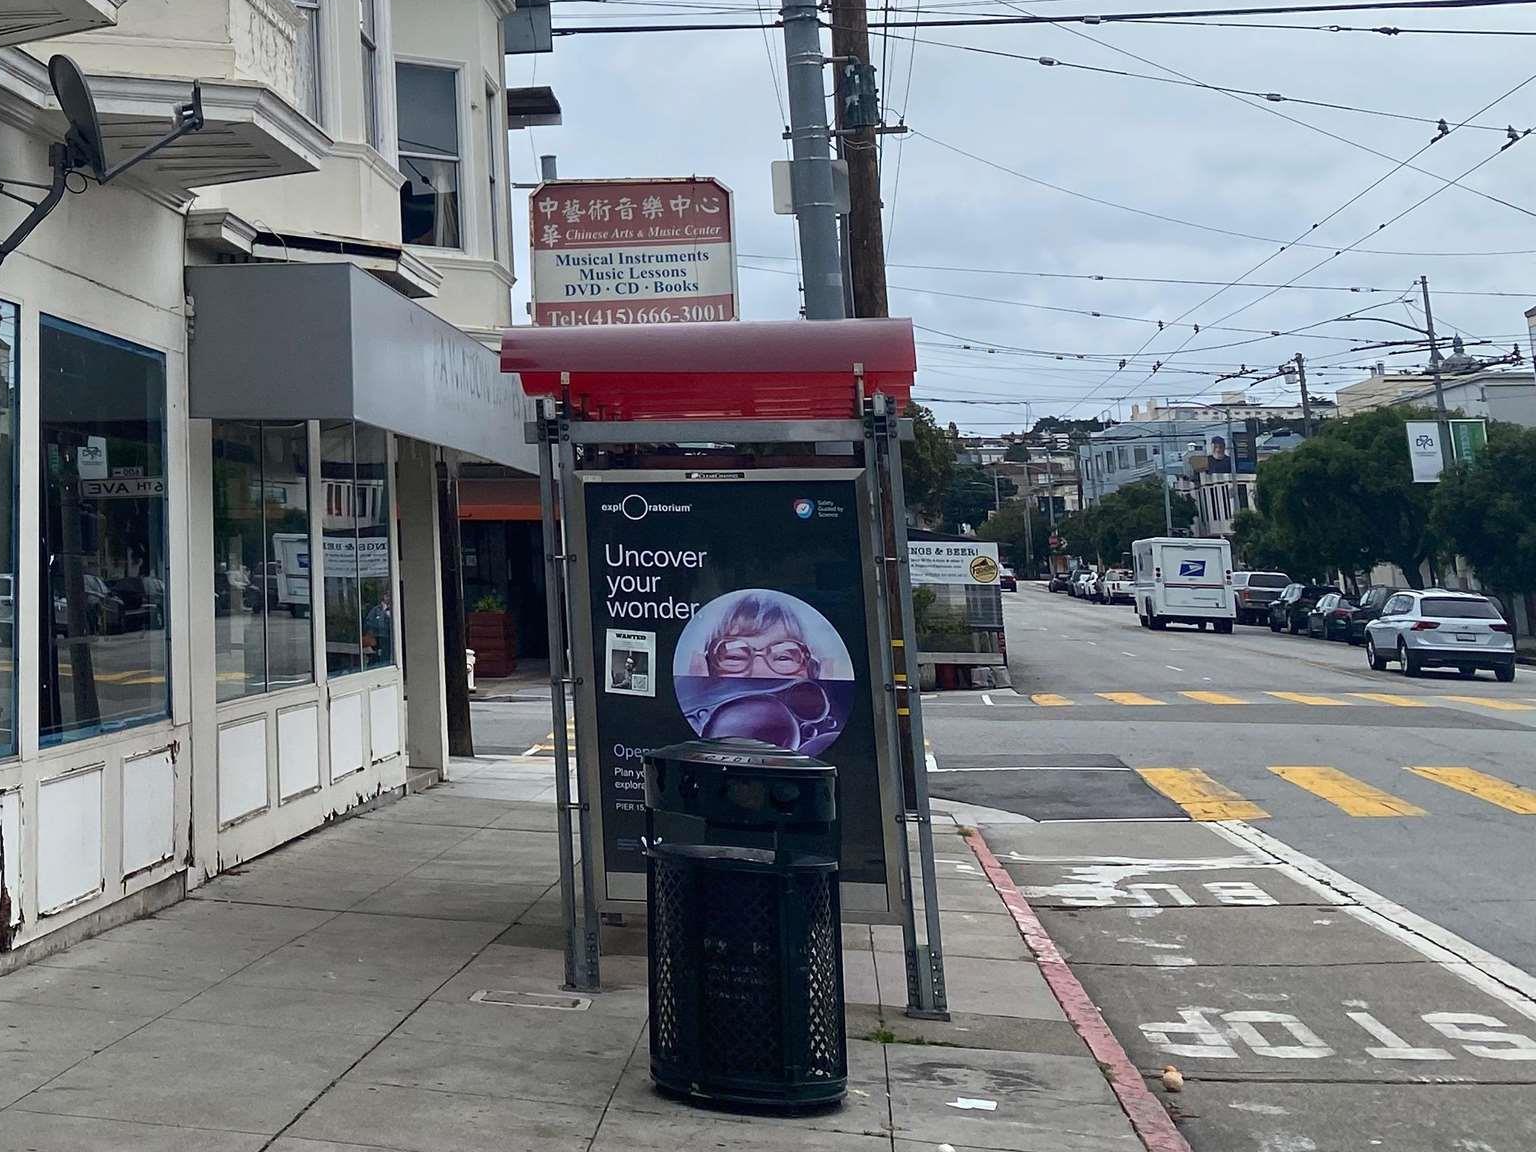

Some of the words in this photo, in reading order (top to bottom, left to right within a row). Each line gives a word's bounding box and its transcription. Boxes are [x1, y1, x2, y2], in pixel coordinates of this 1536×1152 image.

[565, 228, 609, 241] Chinese
[612, 227, 634, 239] Arts
[648, 225, 681, 237] Music
[684, 224, 721, 237] Center
[556, 252, 613, 267] Musical
[618, 251, 710, 265] Instruments
[579, 268, 624, 281] Music
[629, 266, 687, 279] Lessons
[565, 283, 602, 297] DVD
[615, 282, 640, 295] CD
[654, 280, 699, 294] Books
[605, 543, 708, 568] Uncover
[946, 548, 979, 556] BEER!
[606, 575, 661, 598] your
[615, 633, 647, 641] WANTED
[614, 767, 634, 777] Plan
[616, 802, 634, 811] PIER
[1138, 1007, 1536, 1060] STOP
